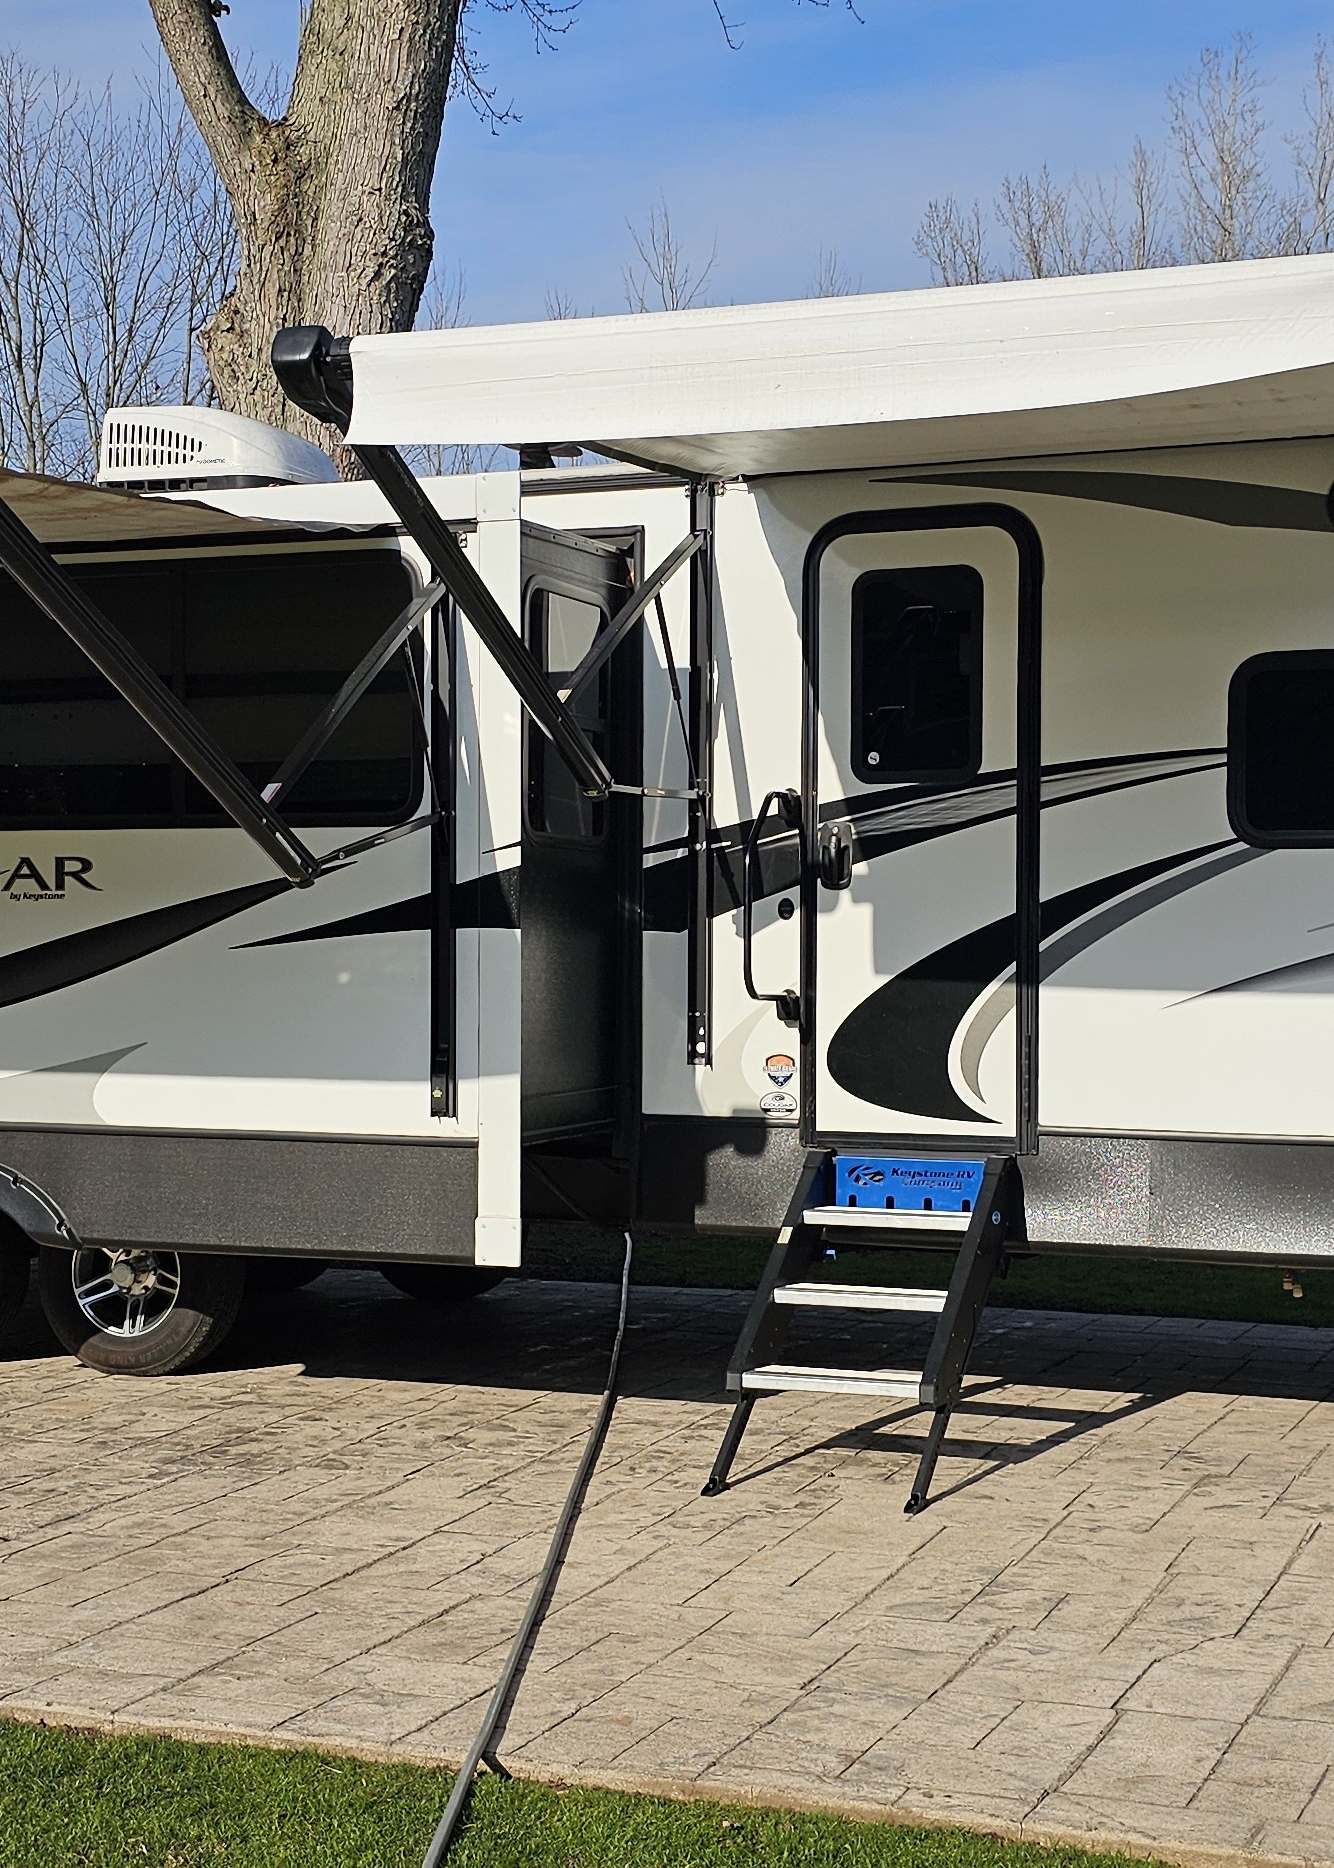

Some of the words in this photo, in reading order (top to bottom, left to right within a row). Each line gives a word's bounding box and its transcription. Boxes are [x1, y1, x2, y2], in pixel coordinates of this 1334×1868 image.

[9, 891, 22, 902] by
[23, 891, 66, 902] Keystone
[890, 1167, 955, 1180] Keystone
[956, 1170, 976, 1179] RV
